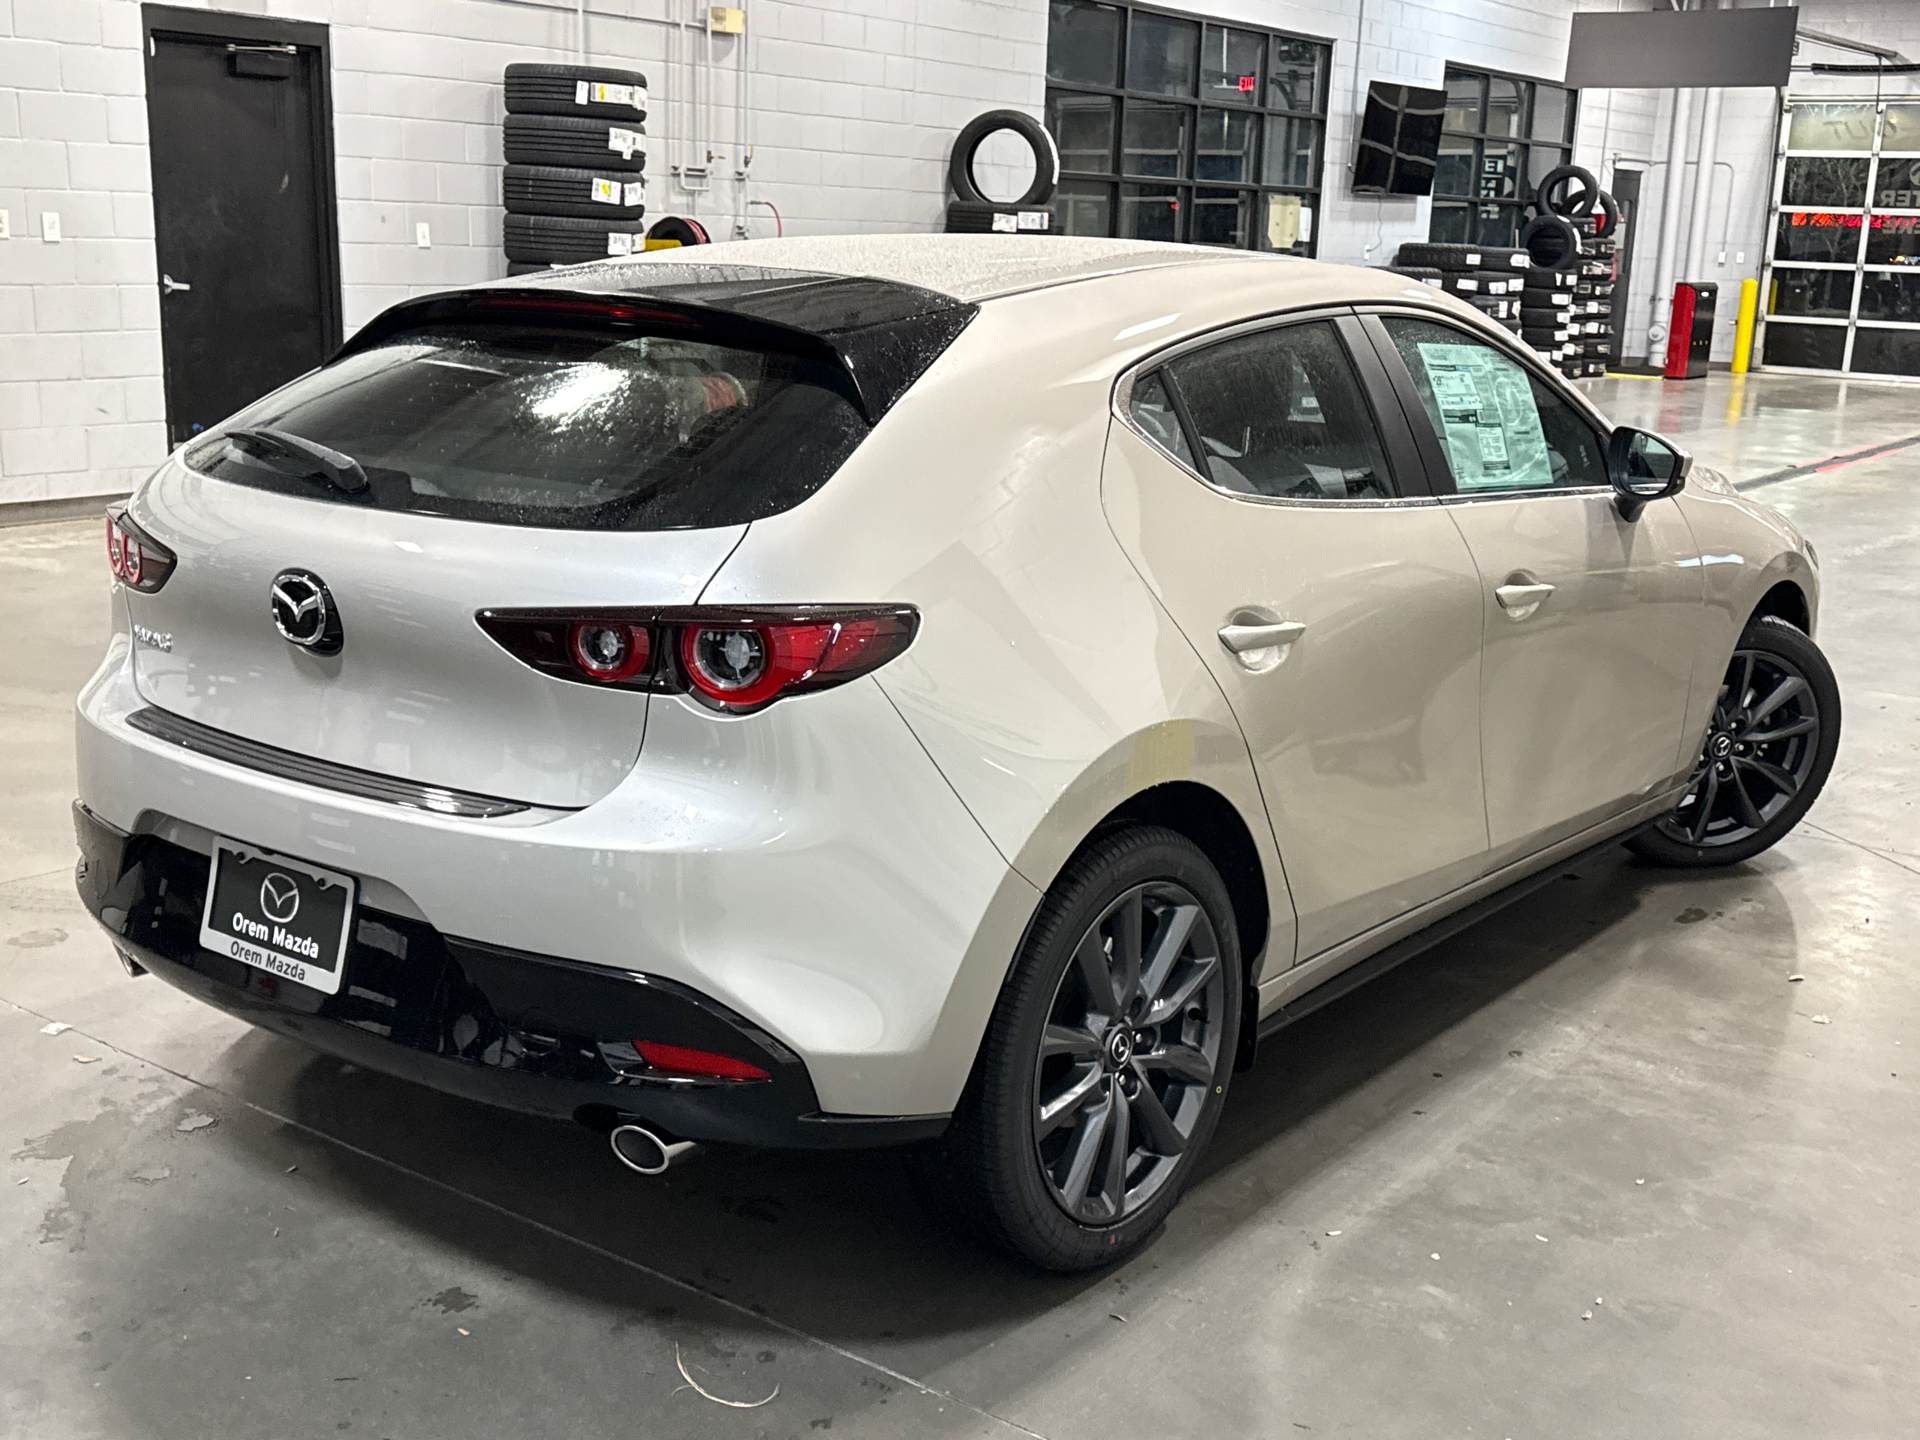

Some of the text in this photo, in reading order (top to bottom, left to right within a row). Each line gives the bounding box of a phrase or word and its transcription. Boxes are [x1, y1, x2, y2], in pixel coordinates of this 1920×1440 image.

[1239, 76, 1255, 91] EXIT
[232, 912, 319, 959] Orem Mazda
[230, 941, 306, 981] Orem Mazda
